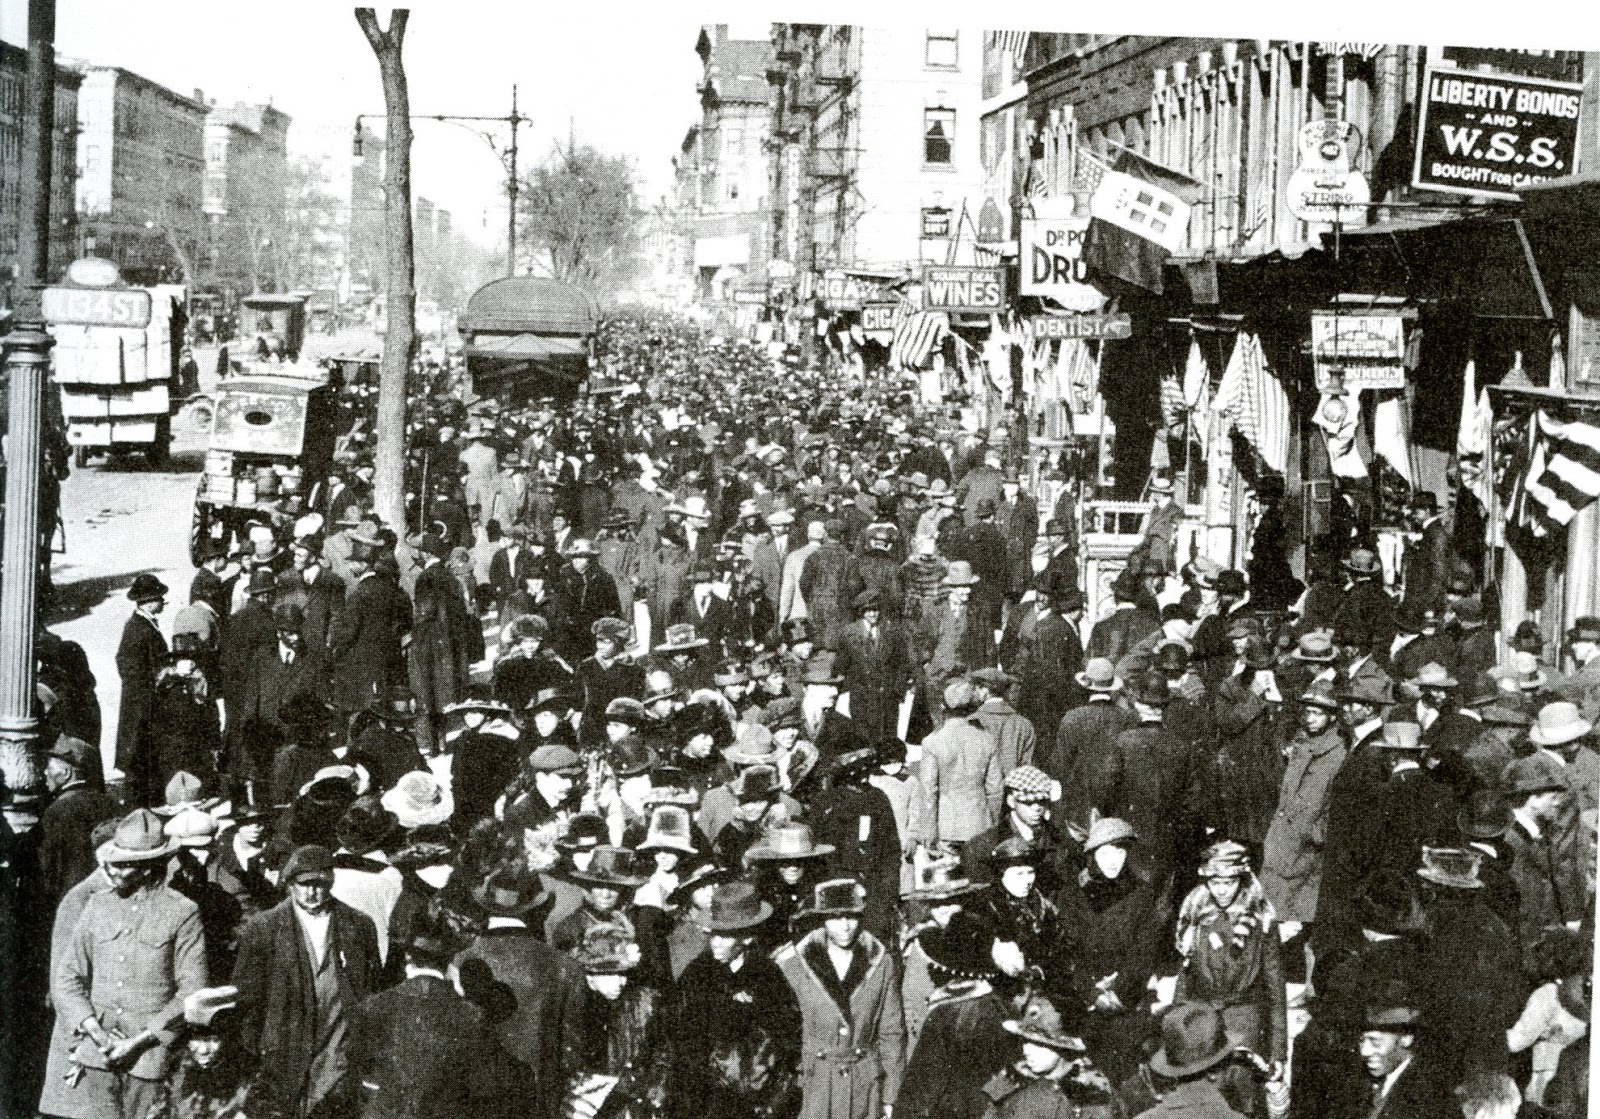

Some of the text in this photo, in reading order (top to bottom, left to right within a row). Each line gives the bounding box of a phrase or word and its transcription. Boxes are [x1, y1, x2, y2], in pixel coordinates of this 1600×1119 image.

[1431, 78, 1579, 118] LIBERTY BONDS
[1480, 113, 1518, 127] AND
[1440, 124, 1564, 170] W.S.S.
[1431, 162, 1552, 187] BOUGHT FOR CAS
[1068, 230, 1086, 246] PO
[1031, 242, 1090, 285] DRU
[929, 282, 1000, 306] WINES
[1035, 318, 1103, 336] DENTIST
